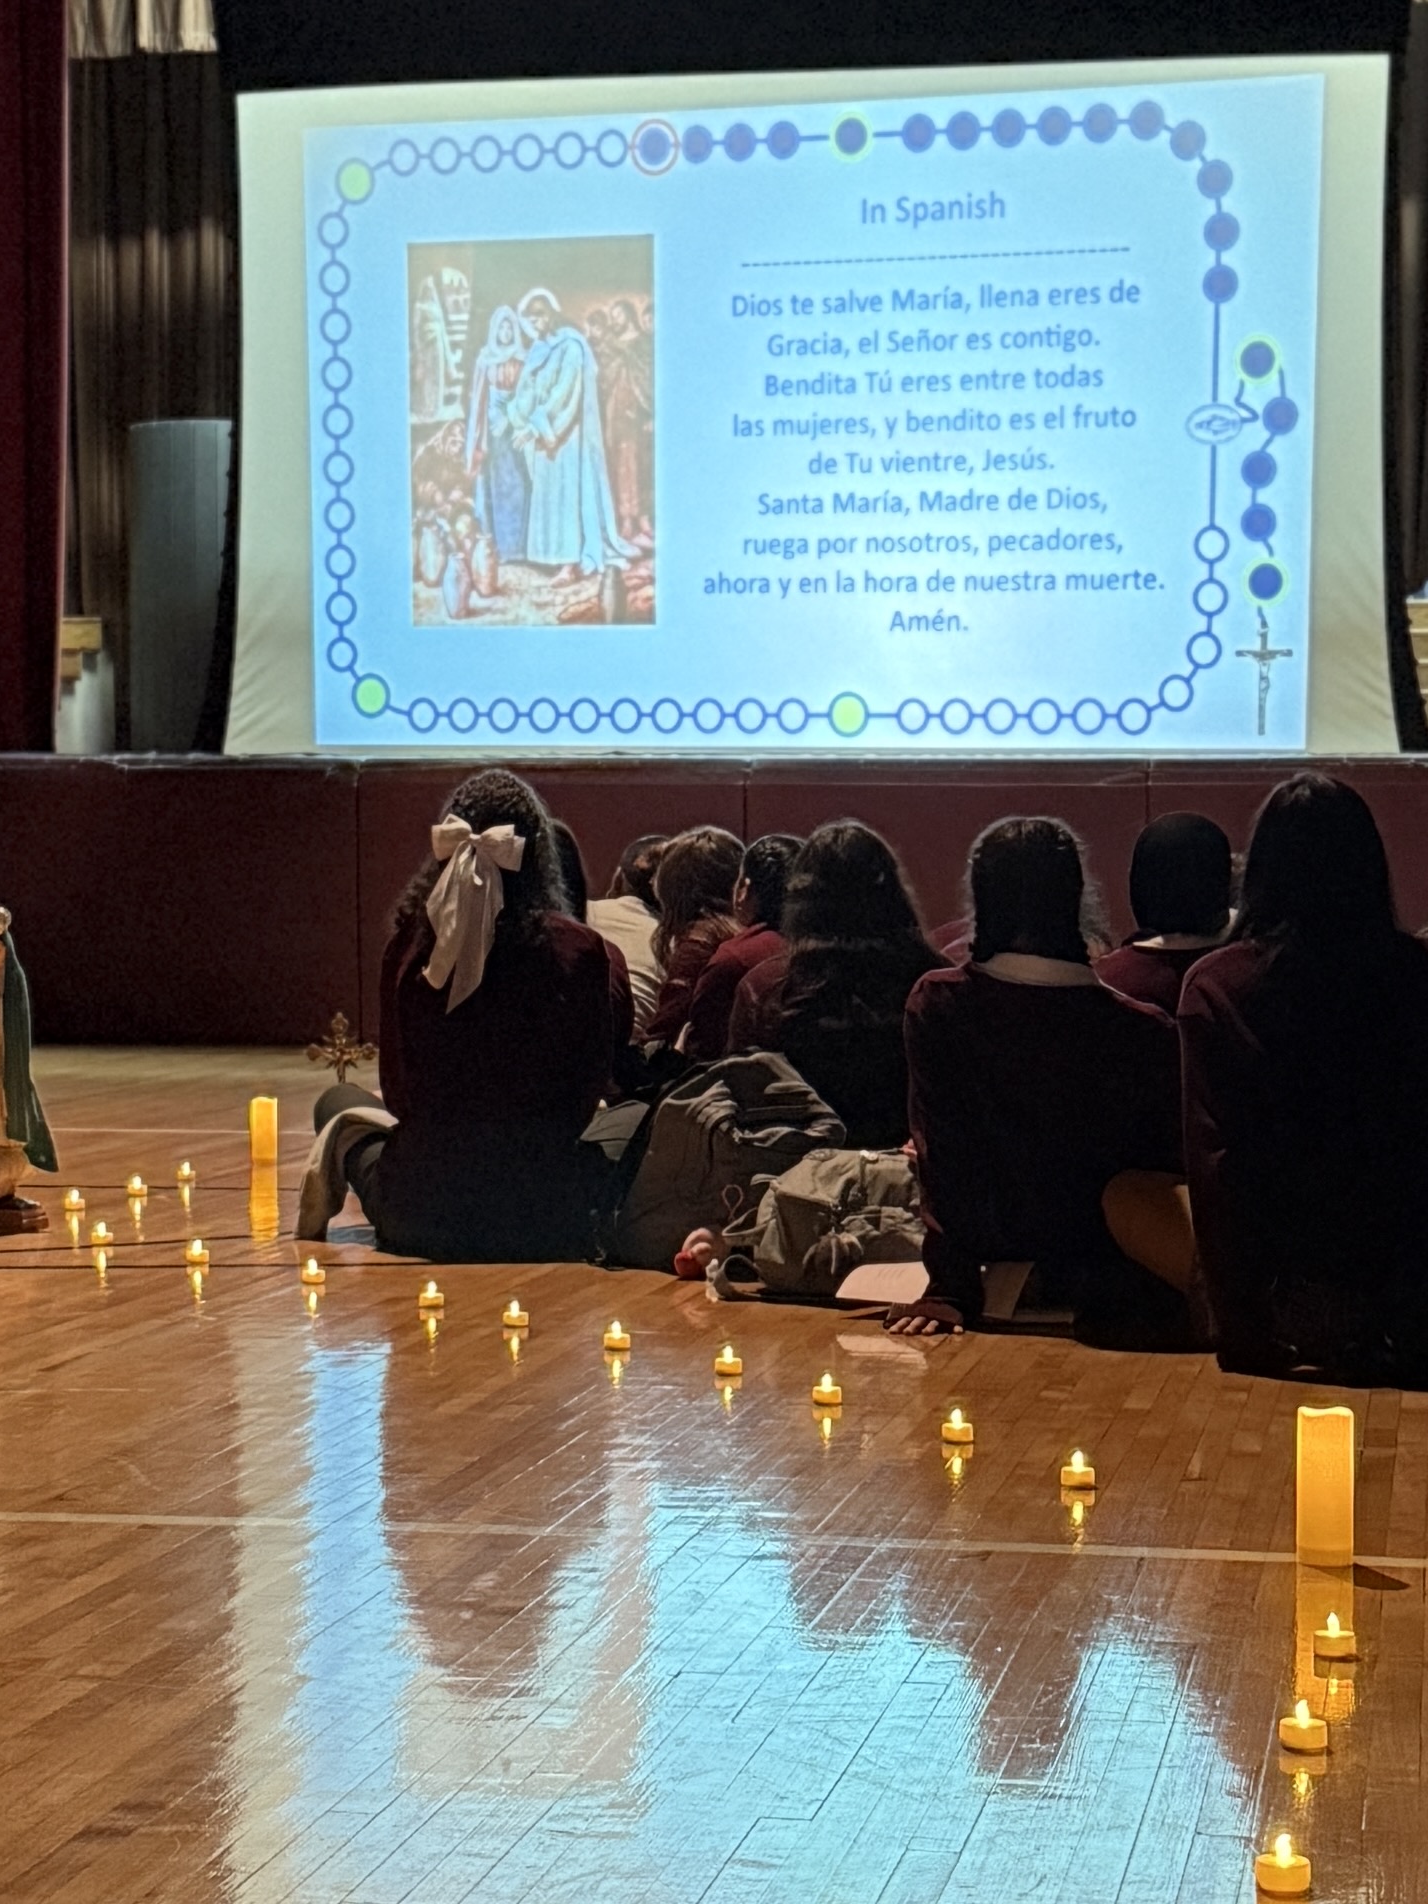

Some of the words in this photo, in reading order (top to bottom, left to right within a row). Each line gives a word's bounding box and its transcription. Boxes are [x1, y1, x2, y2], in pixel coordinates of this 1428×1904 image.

[861, 198, 886, 224] In
[896, 190, 1005, 229] Spanish
[732, 294, 783, 317] Dios
[790, 294, 814, 316] te
[822, 289, 883, 315] salve
[891, 285, 971, 313] María,
[980, 284, 1039, 309] llena
[1048, 286, 1101, 306] eres
[1109, 279, 1140, 304] de
[767, 332, 850, 358] Gracia,
[858, 330, 879, 354] el
[887, 329, 959, 353] Señor
[965, 332, 993, 351] es
[1000, 324, 1100, 353] contigo.
[765, 372, 857, 397] Bendita
[864, 370, 892, 394] Tú
[900, 374, 952, 393] eres
[959, 369, 1026, 391] entre
[1033, 364, 1104, 389] todas
[733, 413, 765, 437] las
[773, 414, 876, 441] mujeres,
[884, 417, 898, 439] y
[906, 407, 1001, 433] bendito
[1009, 412, 1036, 431] es
[1043, 405, 1065, 430] el
[1073, 404, 1137, 429] fruto
[808, 451, 838, 475] de
[845, 452, 873, 474] Tu
[880, 450, 974, 476] vientre,
[982, 447, 1055, 472] Jesús.
[758, 492, 824, 516] Santa
[832, 489, 911, 517] María,
[919, 488, 1000, 513] Madre
[1007, 487, 1038, 511] de
[1046, 487, 1107, 514] Dios,
[743, 537, 809, 560] ruega
[817, 537, 858, 560] por
[865, 532, 979, 556] nosotros,
[987, 527, 1123, 558] pecadores,
[703, 571, 771, 595] ahora
[778, 577, 792, 600] y
[798, 576, 827, 594] en
[836, 569, 855, 593] la
[864, 569, 918, 593] hora
[925, 569, 956, 593] de
[964, 570, 1056, 592] nuestra
[1065, 569, 1165, 591] muerte.
[889, 608, 969, 633] Amén.
